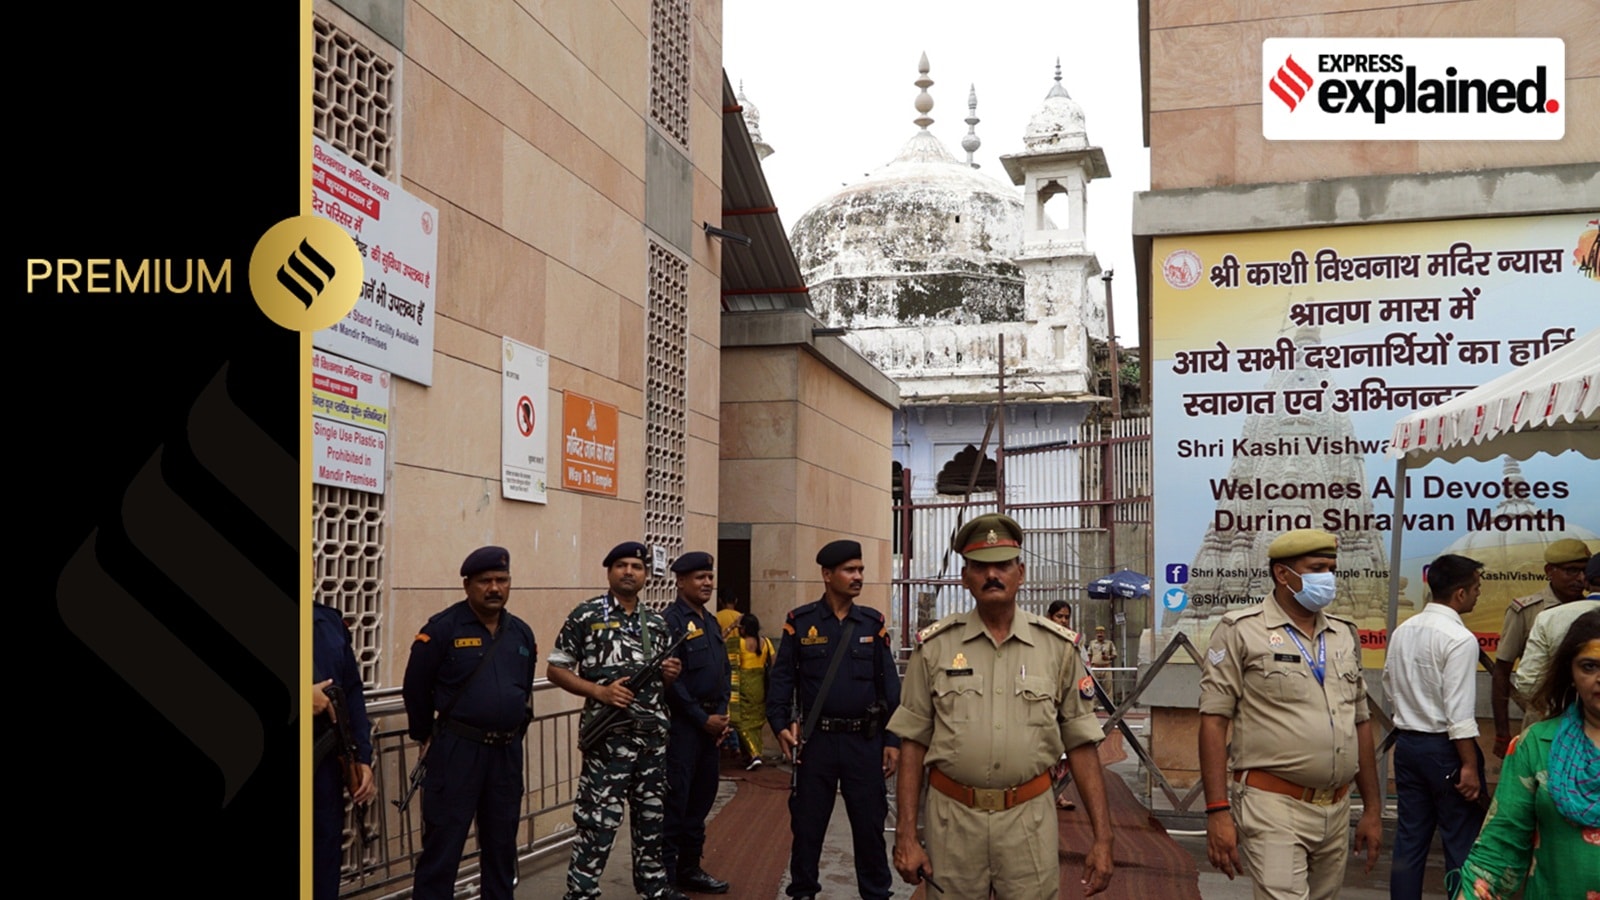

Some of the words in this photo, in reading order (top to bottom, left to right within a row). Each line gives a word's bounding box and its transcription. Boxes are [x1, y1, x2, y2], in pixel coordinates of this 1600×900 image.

[325, 202, 353, 229] परिसर
[354, 215, 364, 233] में
[1210, 254, 1240, 287] श्री
[1246, 251, 1309, 286] काशी
[1315, 249, 1420, 282] विश्वनाथ
[1497, 249, 1564, 273] न्यास
[376, 282, 386, 308] भी
[388, 293, 416, 320] उपलब्ध
[1290, 300, 1372, 326] श्रावण
[1379, 298, 1441, 322] मास
[1449, 287, 1481, 320] में
[339, 322, 360, 339] Mandir
[361, 331, 387, 350] Premises
[374, 319, 394, 338] Facility
[396, 328, 419, 346] Available
[1172, 341, 1230, 374] आये
[1237, 337, 1296, 372] सभी
[1457, 341, 1500, 364] का
[1183, 391, 1276, 417] स्वागत
[1283, 380, 1328, 415] एवं
[314, 422, 337, 441] Single
[339, 428, 353, 443] Use
[354, 431, 377, 448] Plastic
[378, 437, 384, 450] is
[1177, 439, 1223, 458] Shri
[1233, 437, 1299, 457] Kashi
[327, 446, 364, 465] Prohibited
[365, 454, 372, 466] in
[319, 465, 344, 481] Mandir
[345, 470, 377, 488] Premises
[568, 466, 582, 485] Way
[583, 469, 591, 483] To
[592, 471, 612, 489] Temple
[1209, 477, 1362, 501] Welcomes
[1372, 476, 1411, 498] Al
[1423, 476, 1570, 499] Devotees
[1214, 509, 1312, 532] During
[1322, 508, 1454, 532] Shrawan
[1467, 508, 1565, 532] Month
[1191, 568, 1213, 578] Shri
[1216, 568, 1248, 578] Kashi
[1363, 568, 1391, 578] Trus
